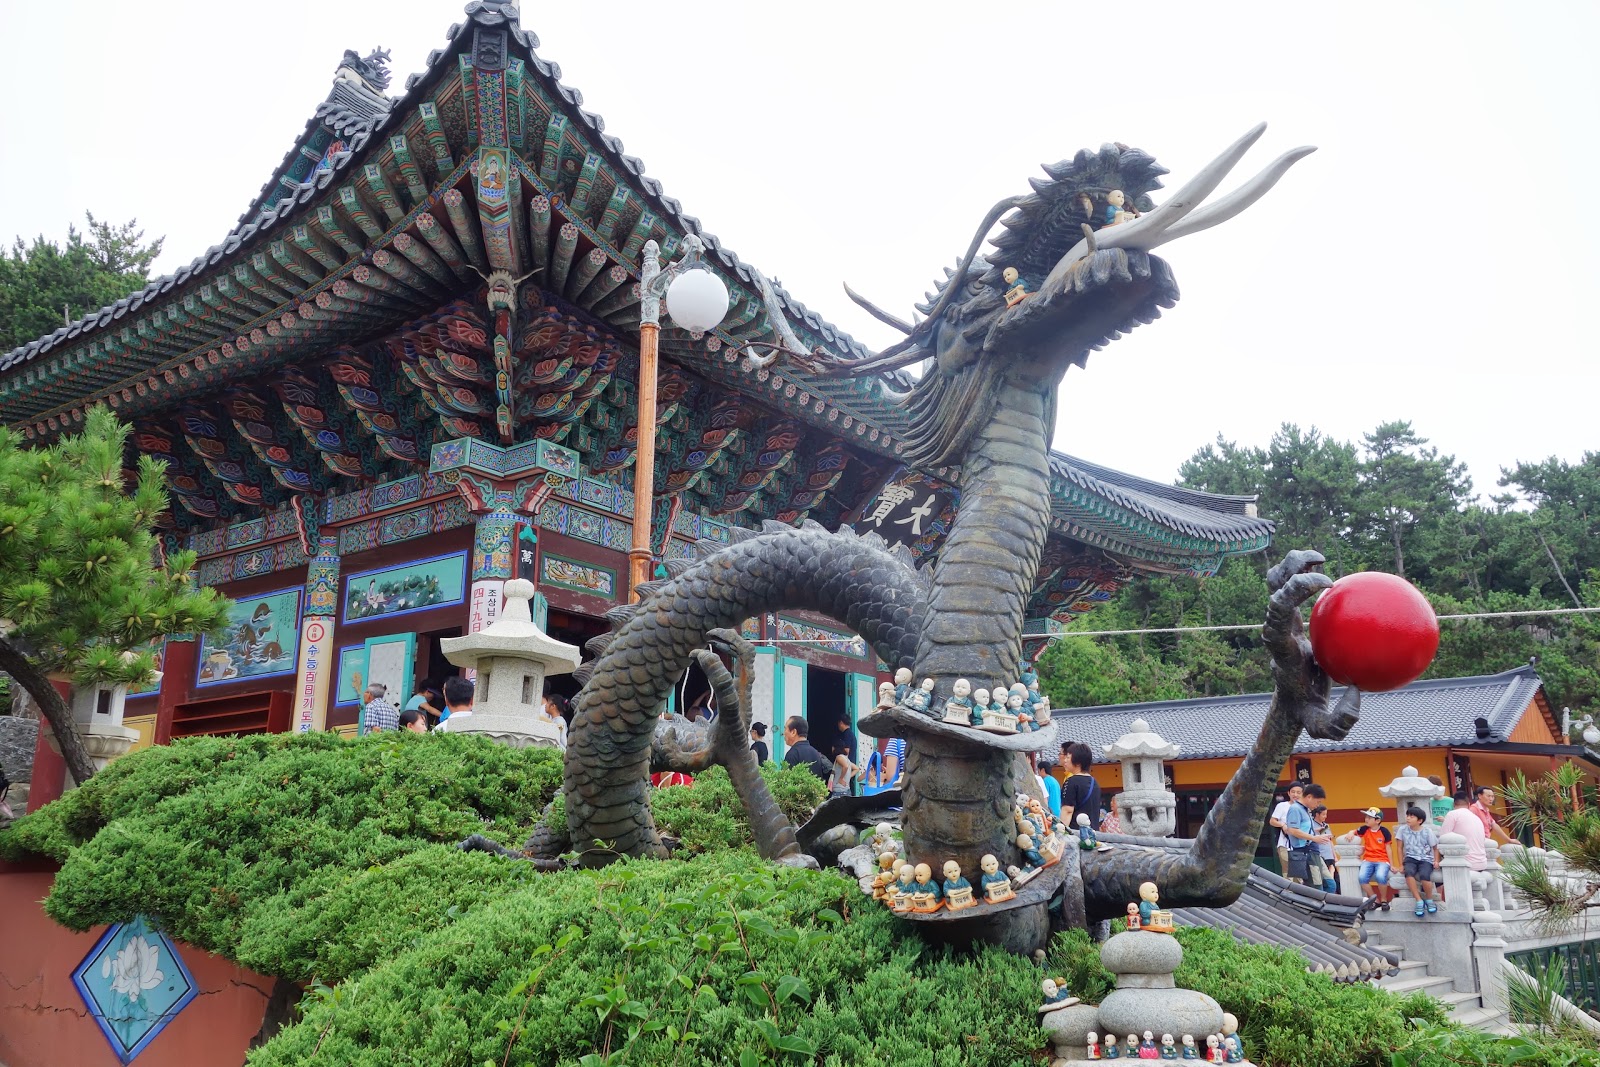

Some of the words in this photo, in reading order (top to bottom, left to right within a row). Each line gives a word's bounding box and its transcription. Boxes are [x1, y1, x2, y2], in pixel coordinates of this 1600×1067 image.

[894, 494, 936, 535] 大
[521, 549, 534, 565] 萬
[472, 587, 484, 633] 四十九日
[487, 589, 497, 617] 조상님
